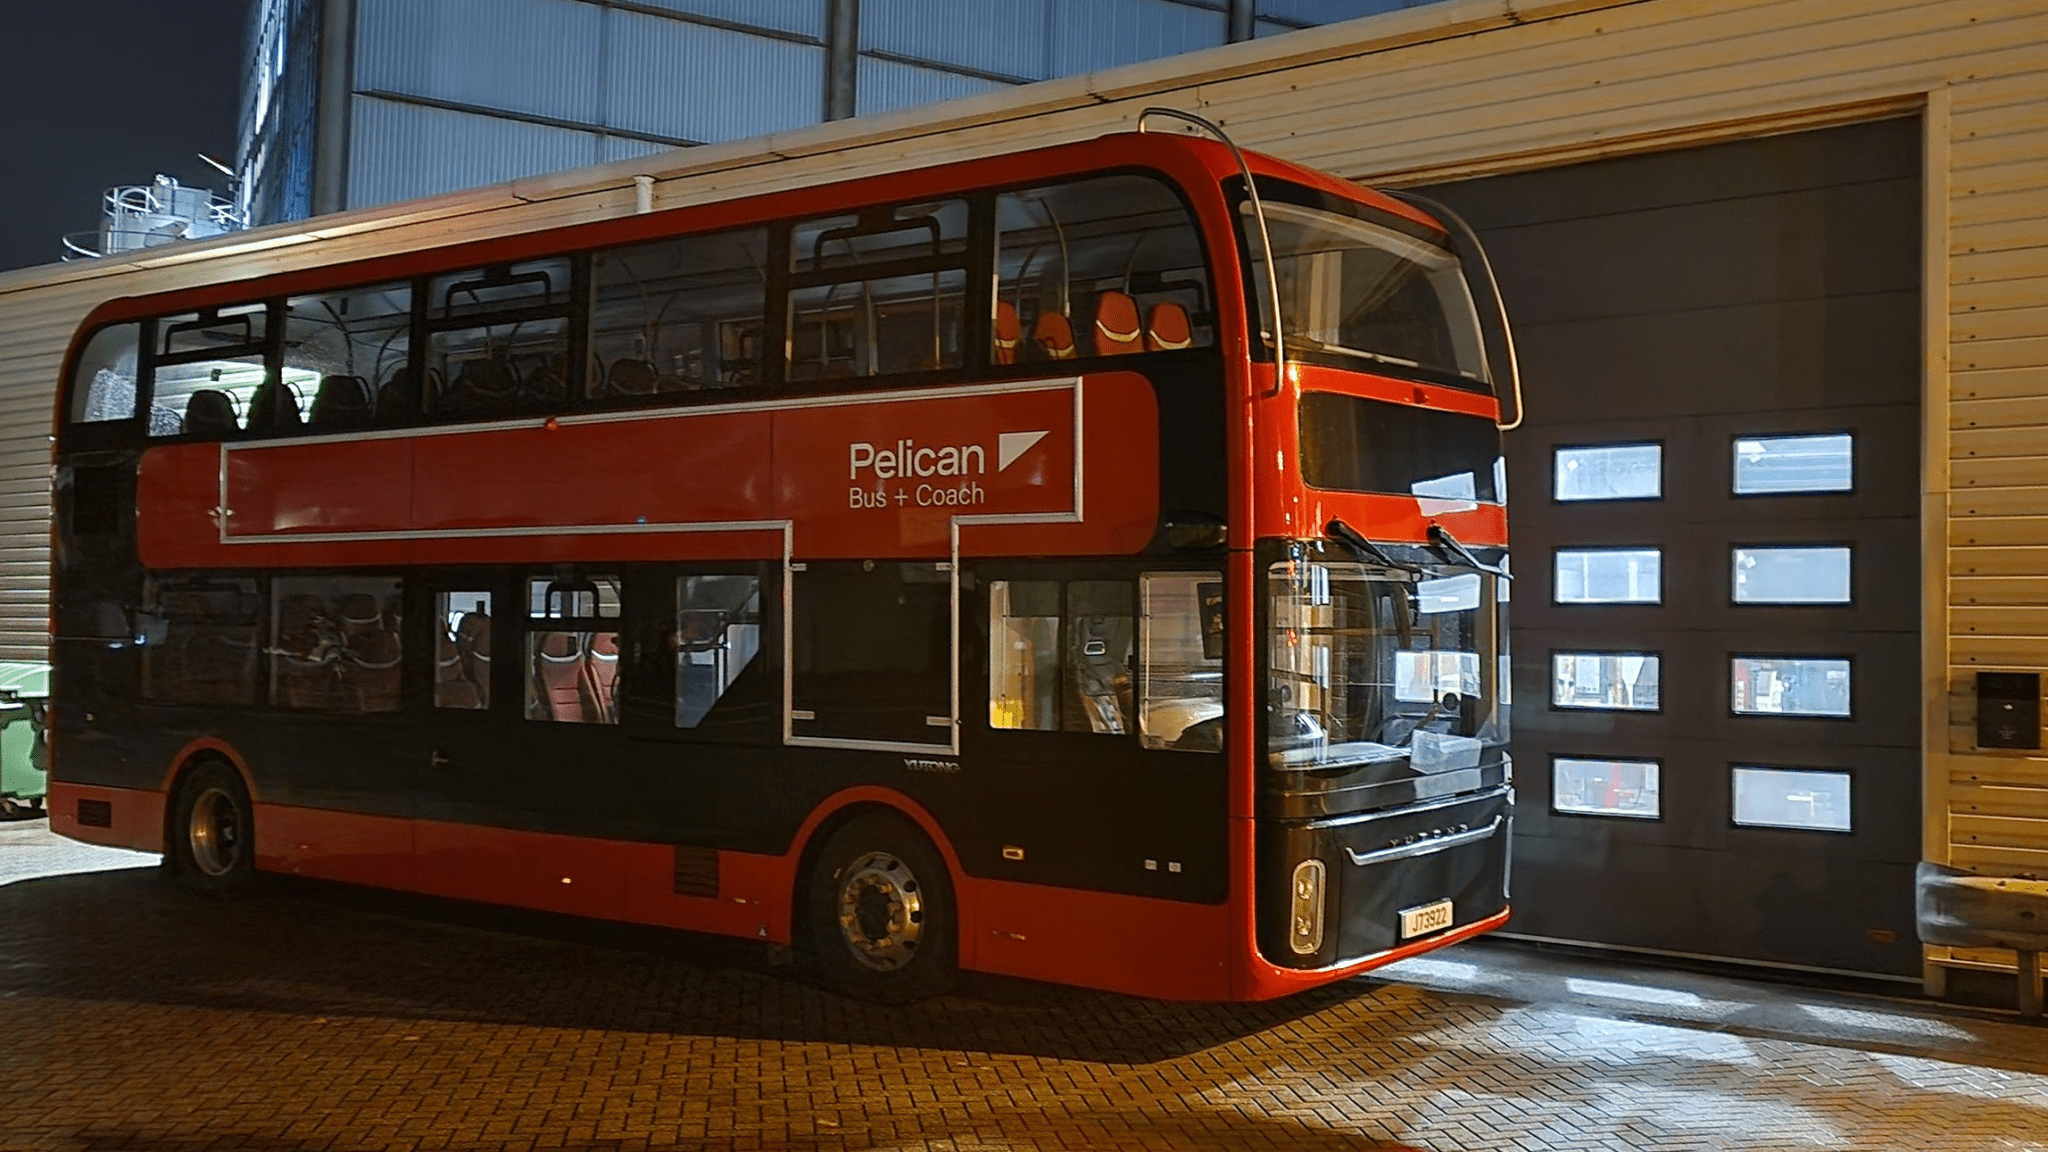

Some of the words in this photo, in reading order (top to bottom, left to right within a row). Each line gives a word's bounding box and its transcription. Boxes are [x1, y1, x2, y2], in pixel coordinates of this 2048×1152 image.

[850, 439, 985, 480] Pelican
[850, 487, 887, 509] Bus
[894, 488, 909, 507] +
[916, 481, 984, 506] Coach
[903, 758, 960, 773] YUTONG
[1412, 906, 1447, 932] J73922
